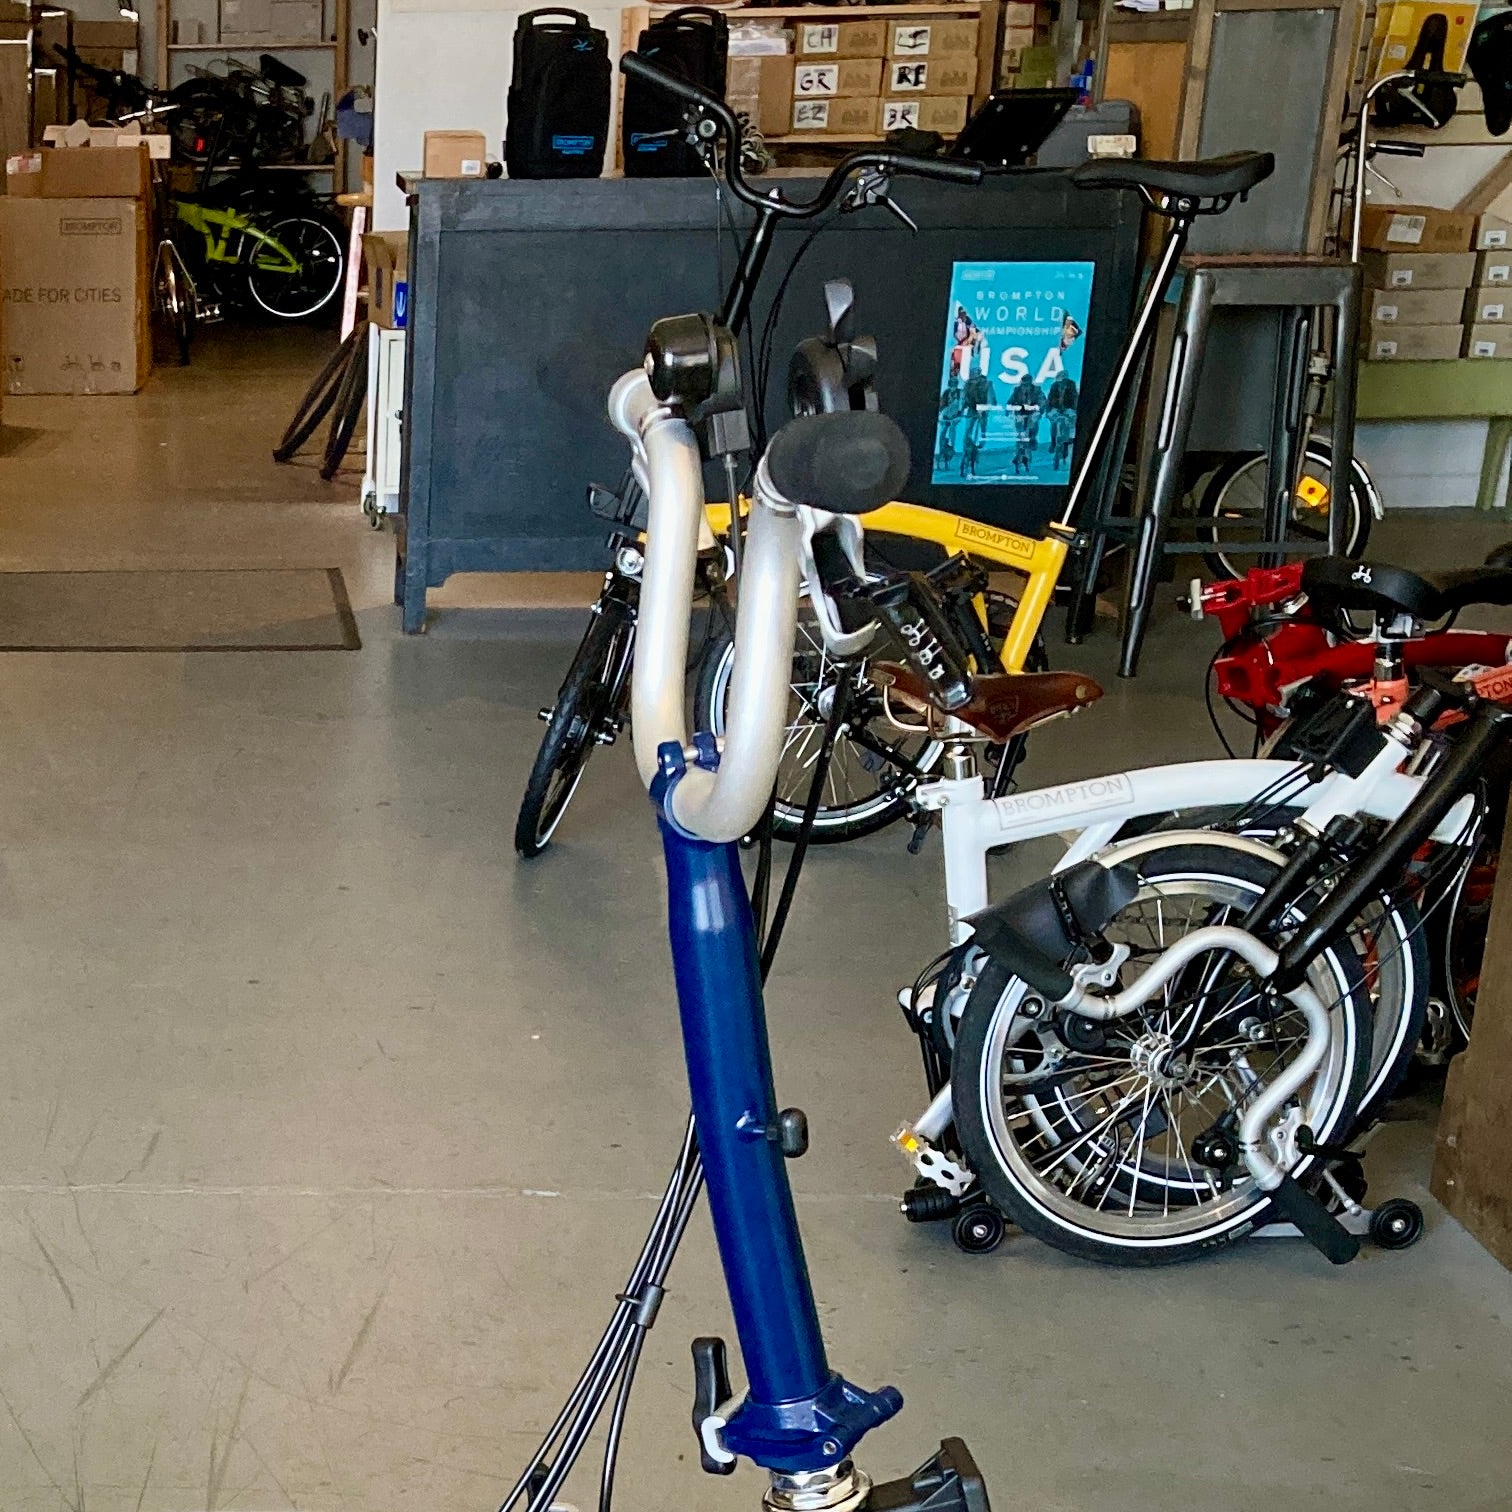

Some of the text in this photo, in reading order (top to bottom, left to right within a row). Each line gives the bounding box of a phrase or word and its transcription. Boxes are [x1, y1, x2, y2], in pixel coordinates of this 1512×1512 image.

[800, 72, 832, 91] GR
[2, 288, 122, 304] ADE FOR CITIES
[976, 290, 1066, 301] BROMPTON
[975, 306, 1064, 322] WORLD
[977, 326, 1062, 336] HAMPIONSHIP
[958, 346, 1066, 386] USA
[962, 523, 1031, 553] BROMPTON
[1001, 777, 1124, 816] BROMPTON
